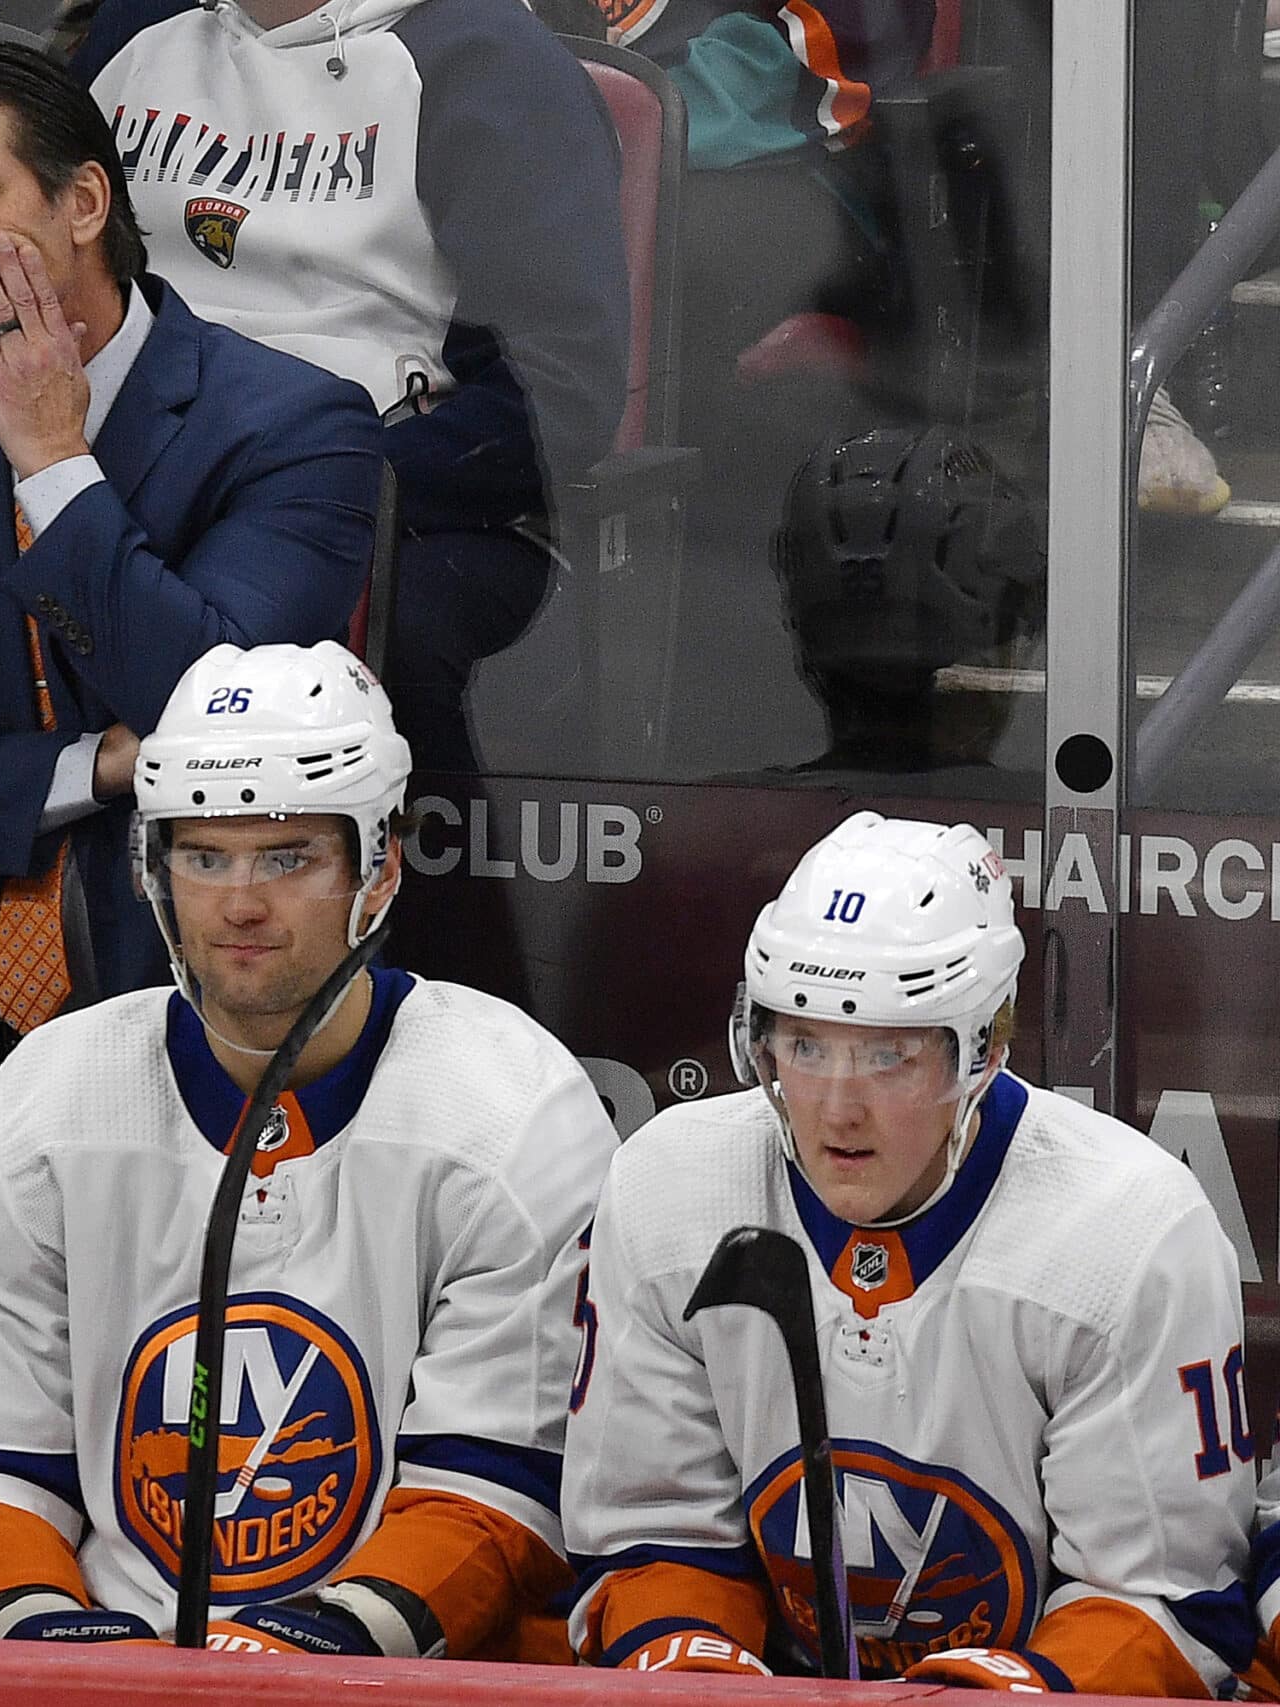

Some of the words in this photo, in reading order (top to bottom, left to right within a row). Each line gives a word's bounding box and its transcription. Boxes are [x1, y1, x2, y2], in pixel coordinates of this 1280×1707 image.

[110, 103, 380, 203] PANTHERS
[206, 687, 254, 715] 26
[823, 889, 867, 924] 10
[986, 828, 1280, 921] HAIRC
[191, 1362, 209, 1449] CCM
[1177, 1343, 1256, 1481] 10
[42, 1625, 131, 1638] WAHLSTROM
